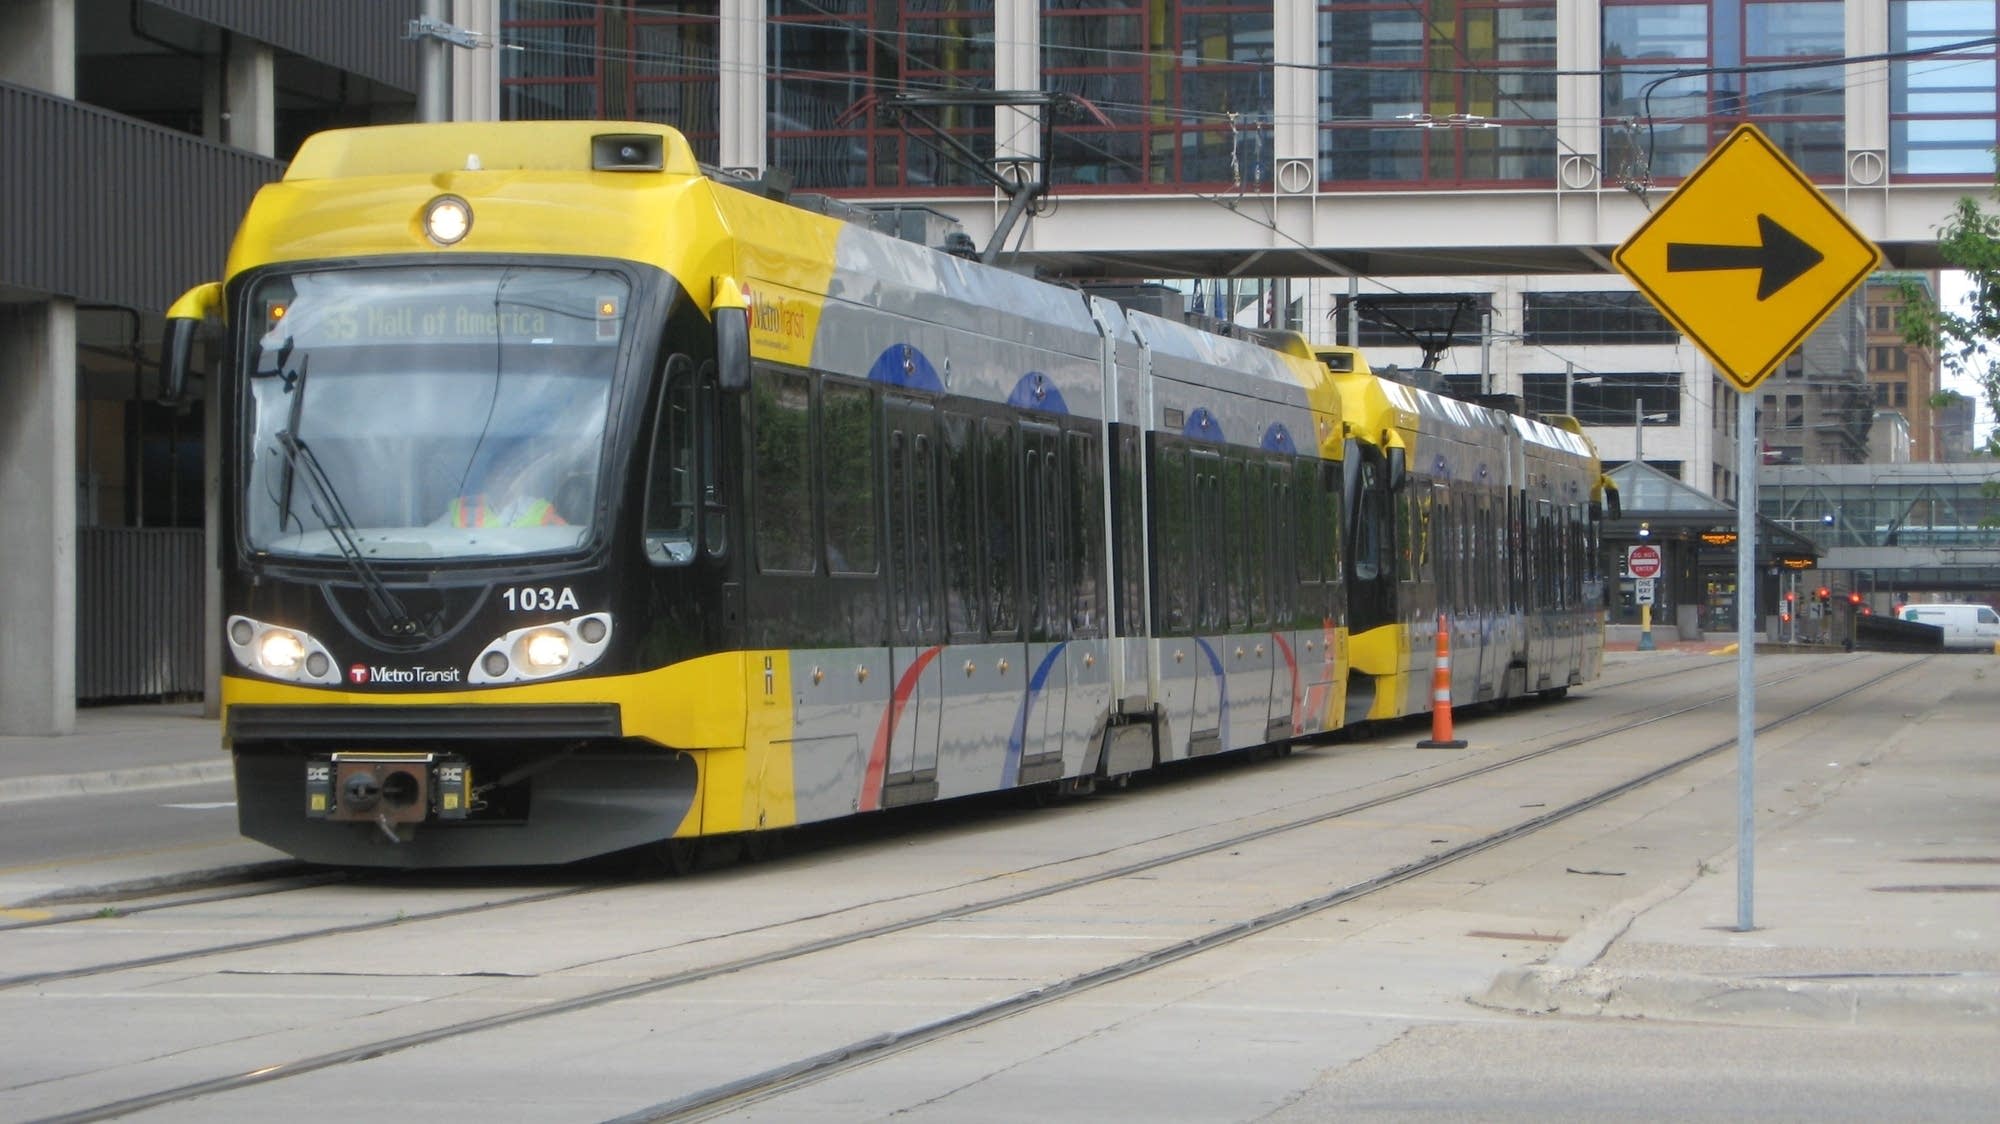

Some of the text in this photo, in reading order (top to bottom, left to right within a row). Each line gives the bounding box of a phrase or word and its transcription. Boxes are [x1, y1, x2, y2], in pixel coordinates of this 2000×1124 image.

[322, 303, 545, 340] 55 Mall of America
[503, 587, 579, 611] 103A
